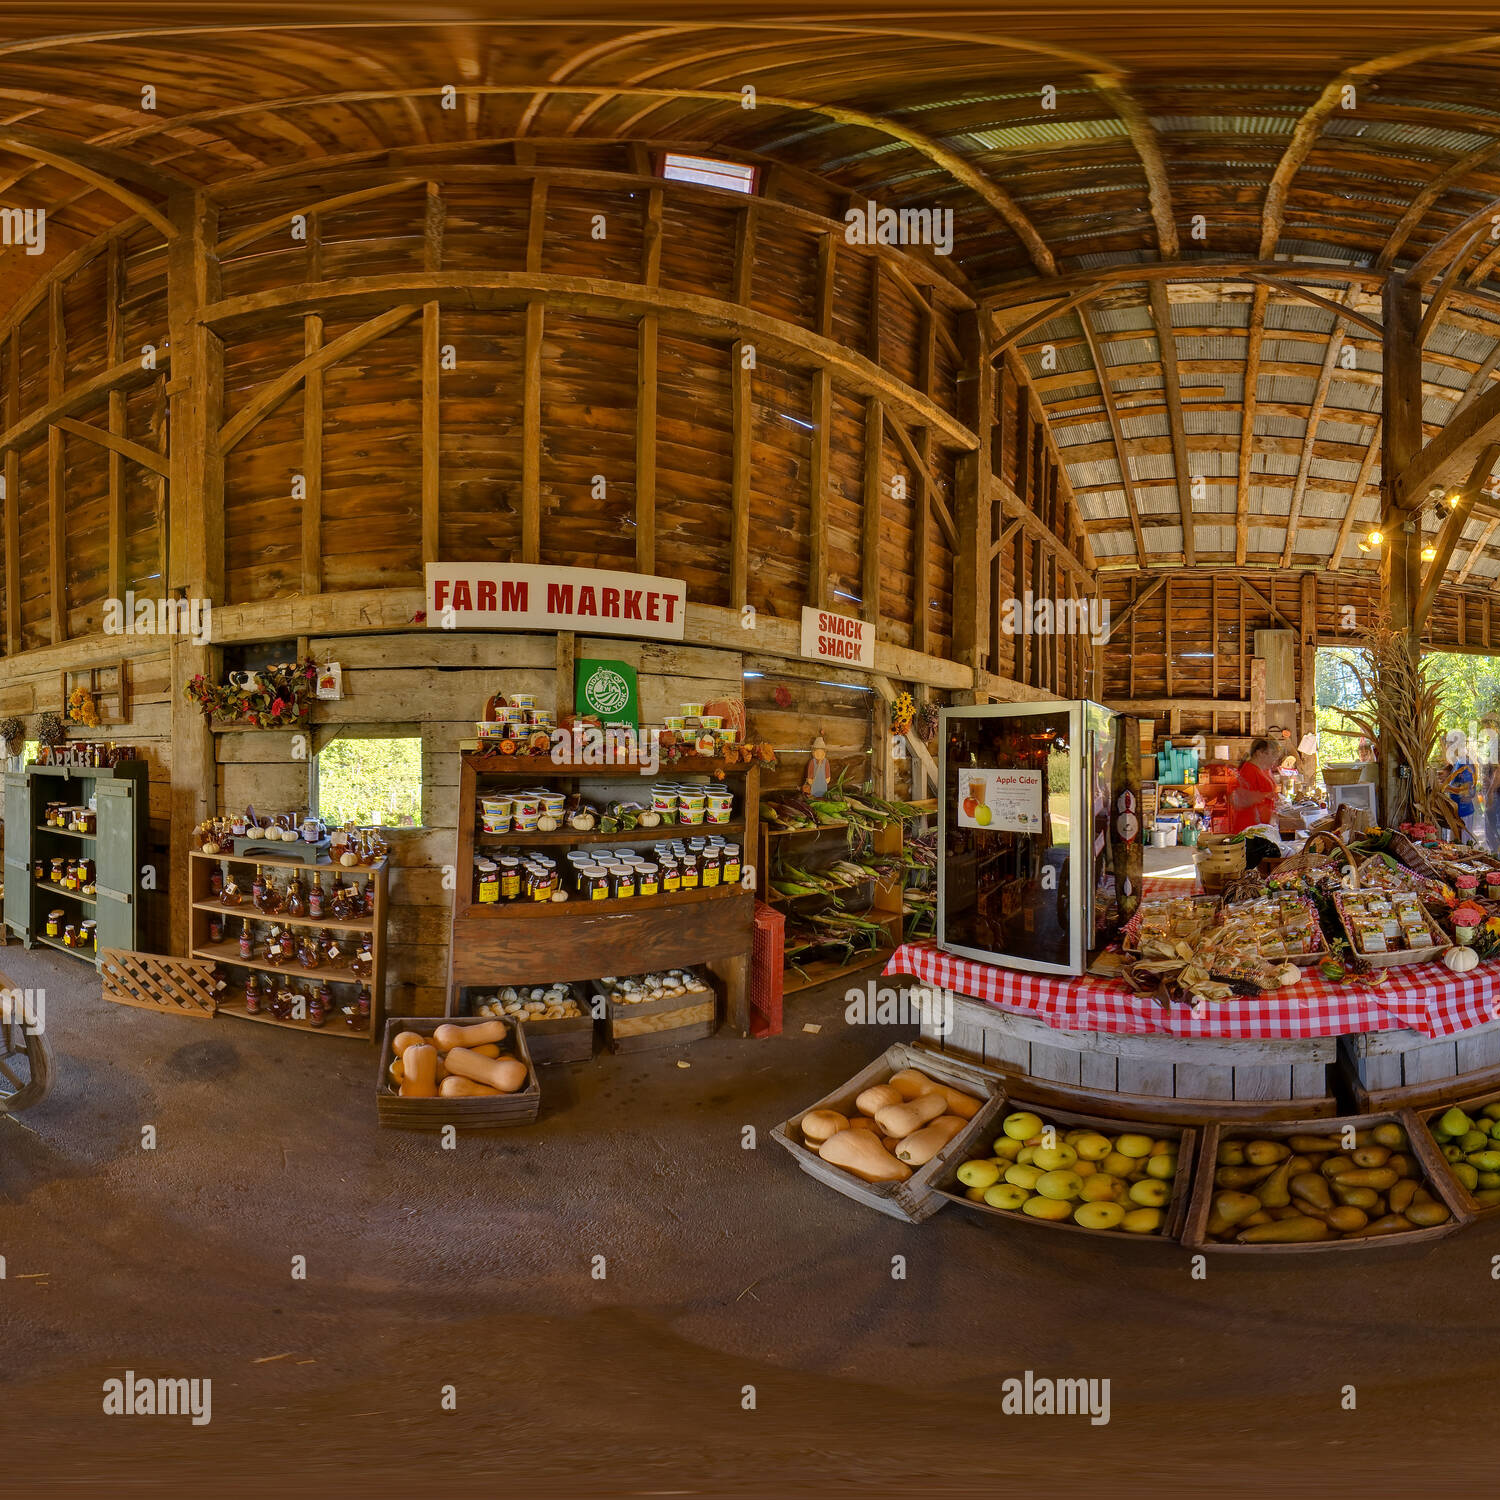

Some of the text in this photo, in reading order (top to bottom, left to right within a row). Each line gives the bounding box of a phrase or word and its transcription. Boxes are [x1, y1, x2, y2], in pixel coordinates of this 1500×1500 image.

[434, 580, 680, 623] FARM MARKET
[818, 613, 863, 640] SNACK
[818, 635, 862, 662] SHACK
[594, 692, 627, 712] NEW YORK
[45, 744, 91, 768] APPLES
[996, 776, 1038, 785] Apple Cider
